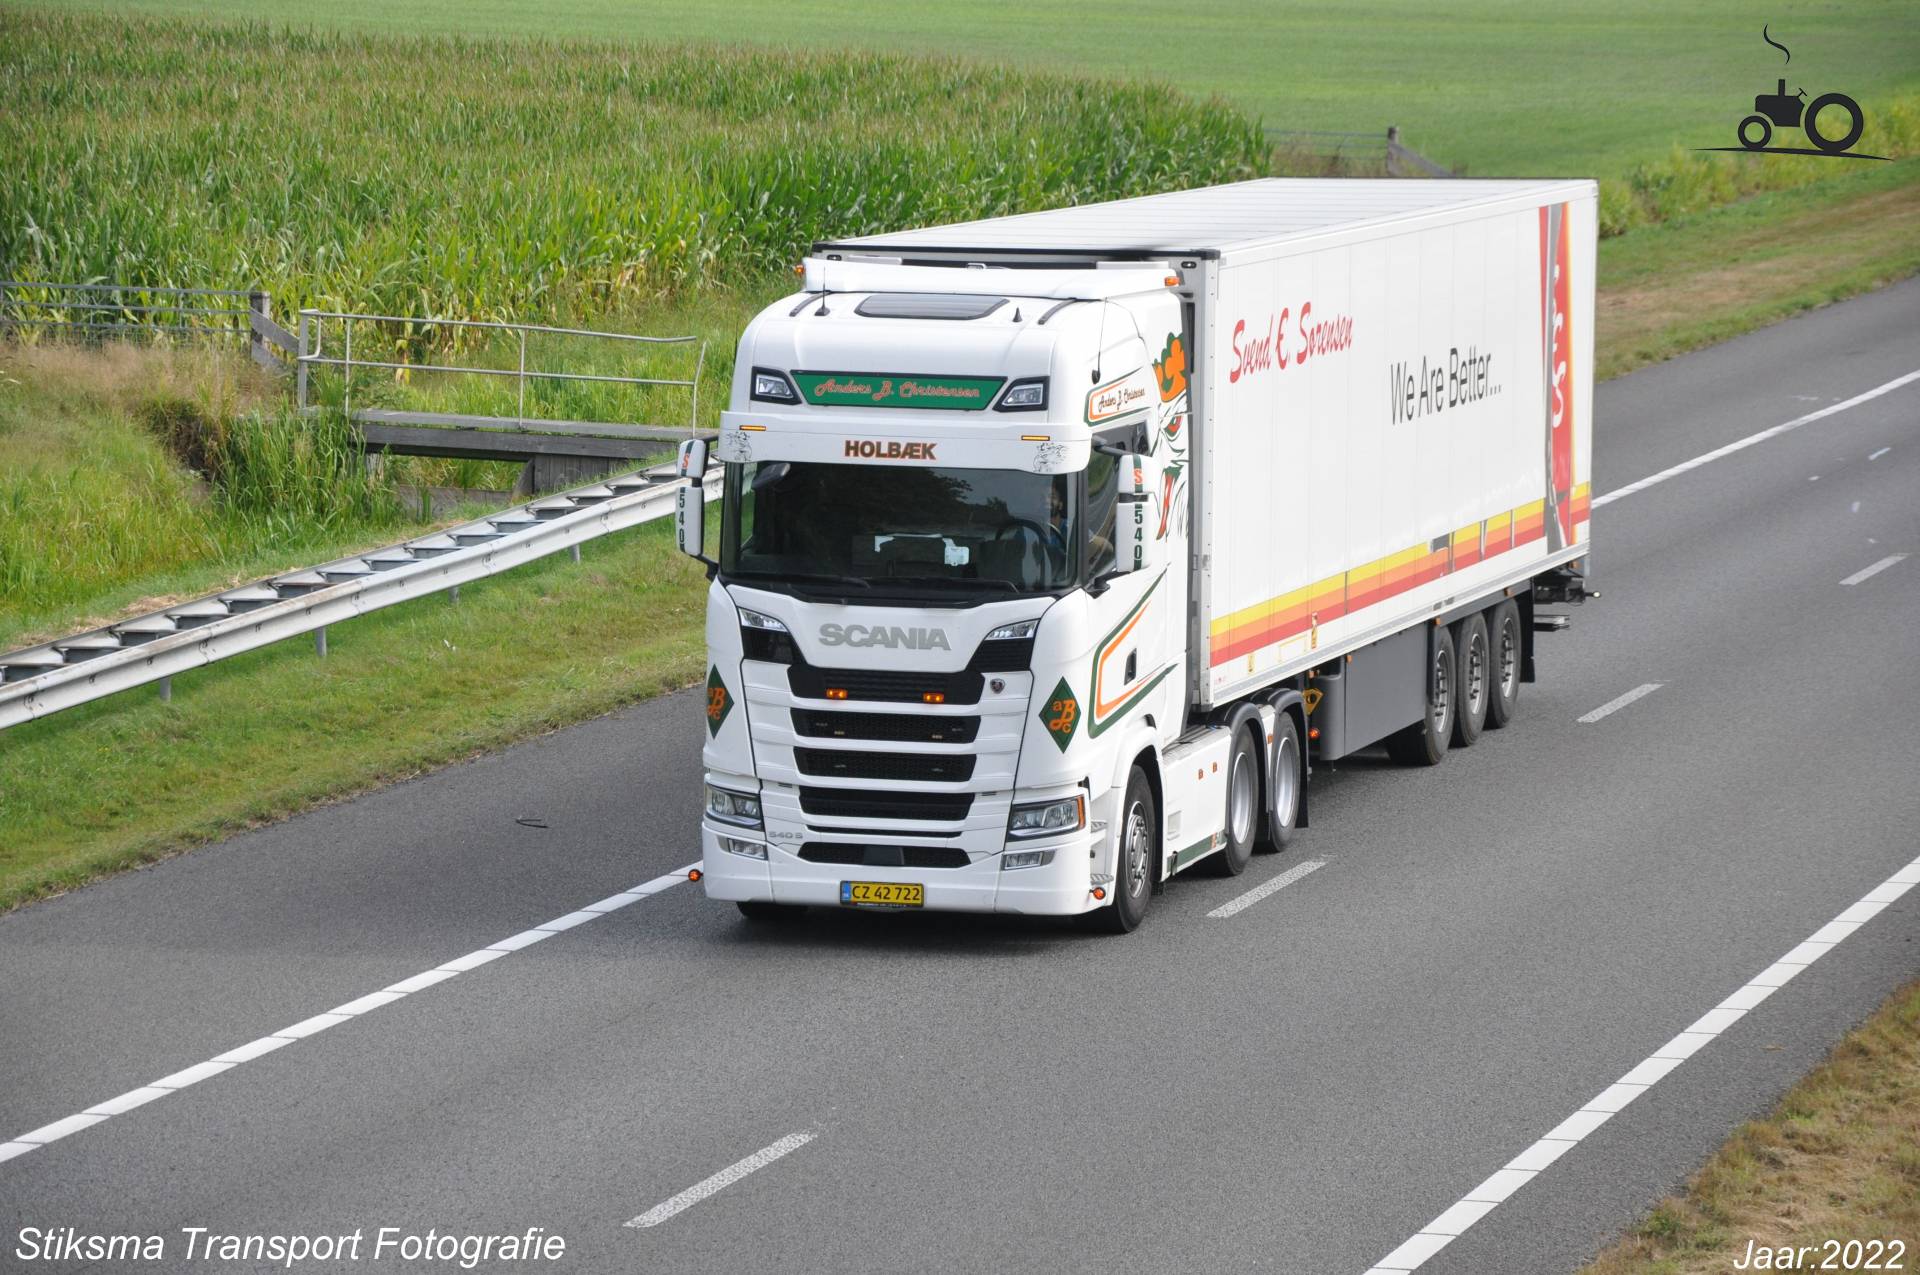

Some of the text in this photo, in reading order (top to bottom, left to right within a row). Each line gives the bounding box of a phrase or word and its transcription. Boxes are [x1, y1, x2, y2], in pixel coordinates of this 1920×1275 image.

[1230, 313, 1273, 384] Svend
[814, 377, 872, 398] Anders
[899, 380, 980, 398] Christensen
[1390, 360, 1415, 425] We
[1417, 354, 1444, 418] Are
[682, 452, 690, 470] S
[844, 439, 938, 461] HOLBÆK
[1133, 467, 1143, 560] S 540
[818, 622, 953, 651] SCANIA
[852, 885, 871, 900] CZ
[873, 886, 892, 901] 42
[894, 887, 921, 902] 722
